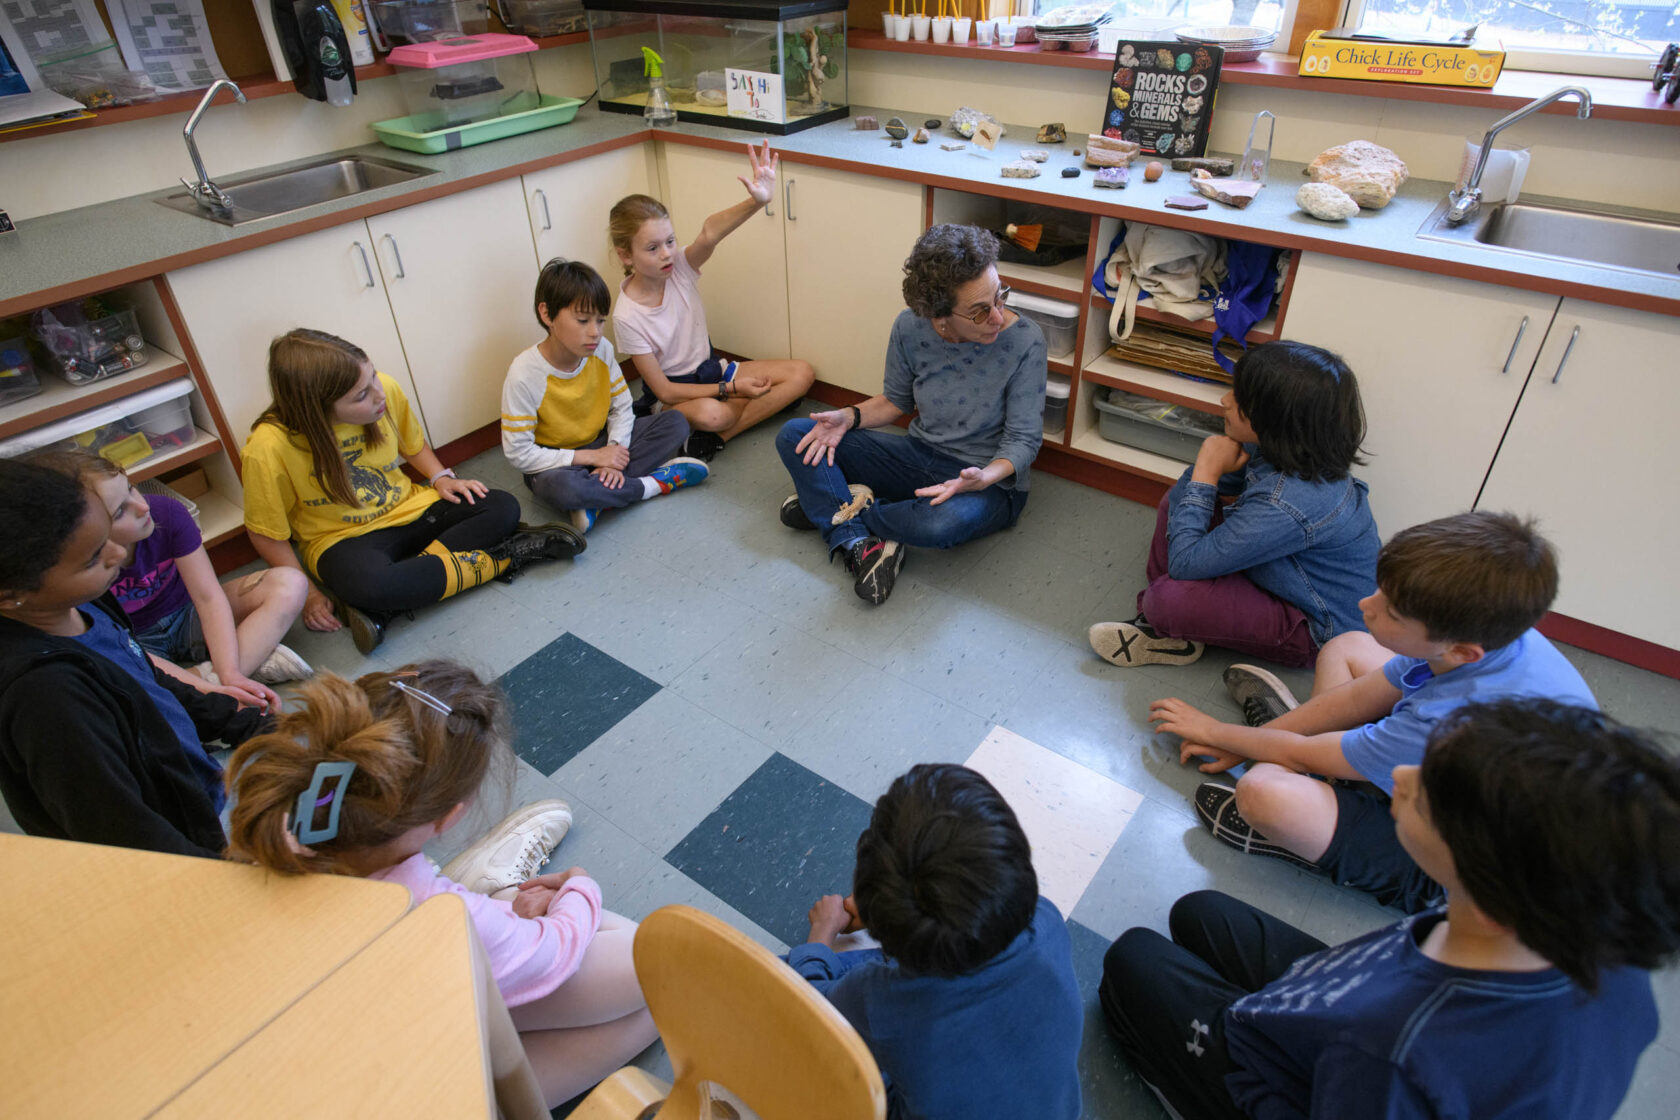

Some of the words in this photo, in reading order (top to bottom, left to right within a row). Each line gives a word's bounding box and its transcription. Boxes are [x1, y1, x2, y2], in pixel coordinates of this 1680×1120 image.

[1336, 48, 1380, 65] Chick
[1386, 50, 1416, 67] Life
[1422, 52, 1466, 73] Cycle
[731, 72, 753, 91] SAY
[1135, 72, 1186, 94] ROCKS
[1132, 90, 1182, 106] MINERALS
[1129, 102, 1139, 118] &
[1140, 103, 1179, 122] GEMS
